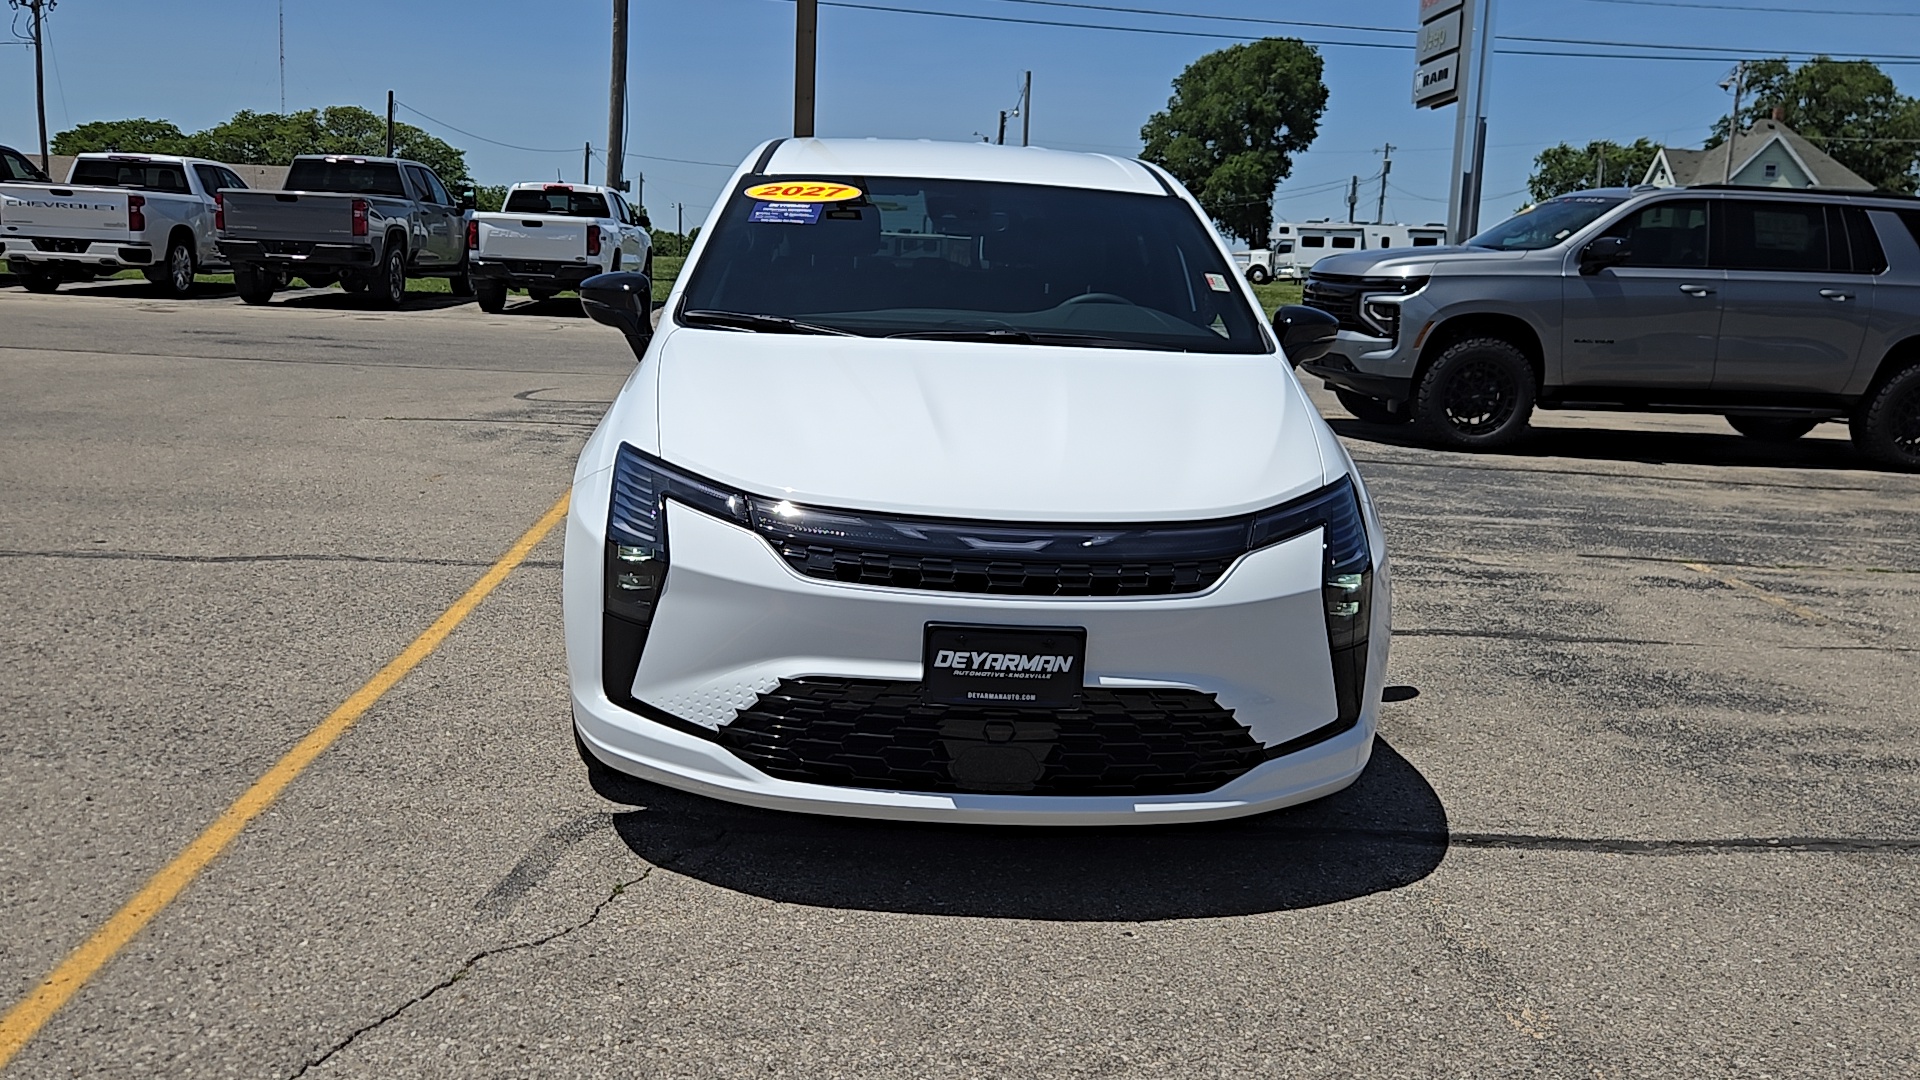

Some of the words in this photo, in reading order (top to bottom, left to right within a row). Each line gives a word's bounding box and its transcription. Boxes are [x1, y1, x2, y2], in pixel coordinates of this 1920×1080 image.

[1423, 26, 1447, 52] Jeep
[1423, 67, 1449, 87] RAM
[757, 186, 850, 197] 2027
[6, 200, 118, 211] CHEVROLET
[934, 650, 1074, 672] DEYARMAN
[967, 692, 1036, 701] DEYARMANAUTO.COM
